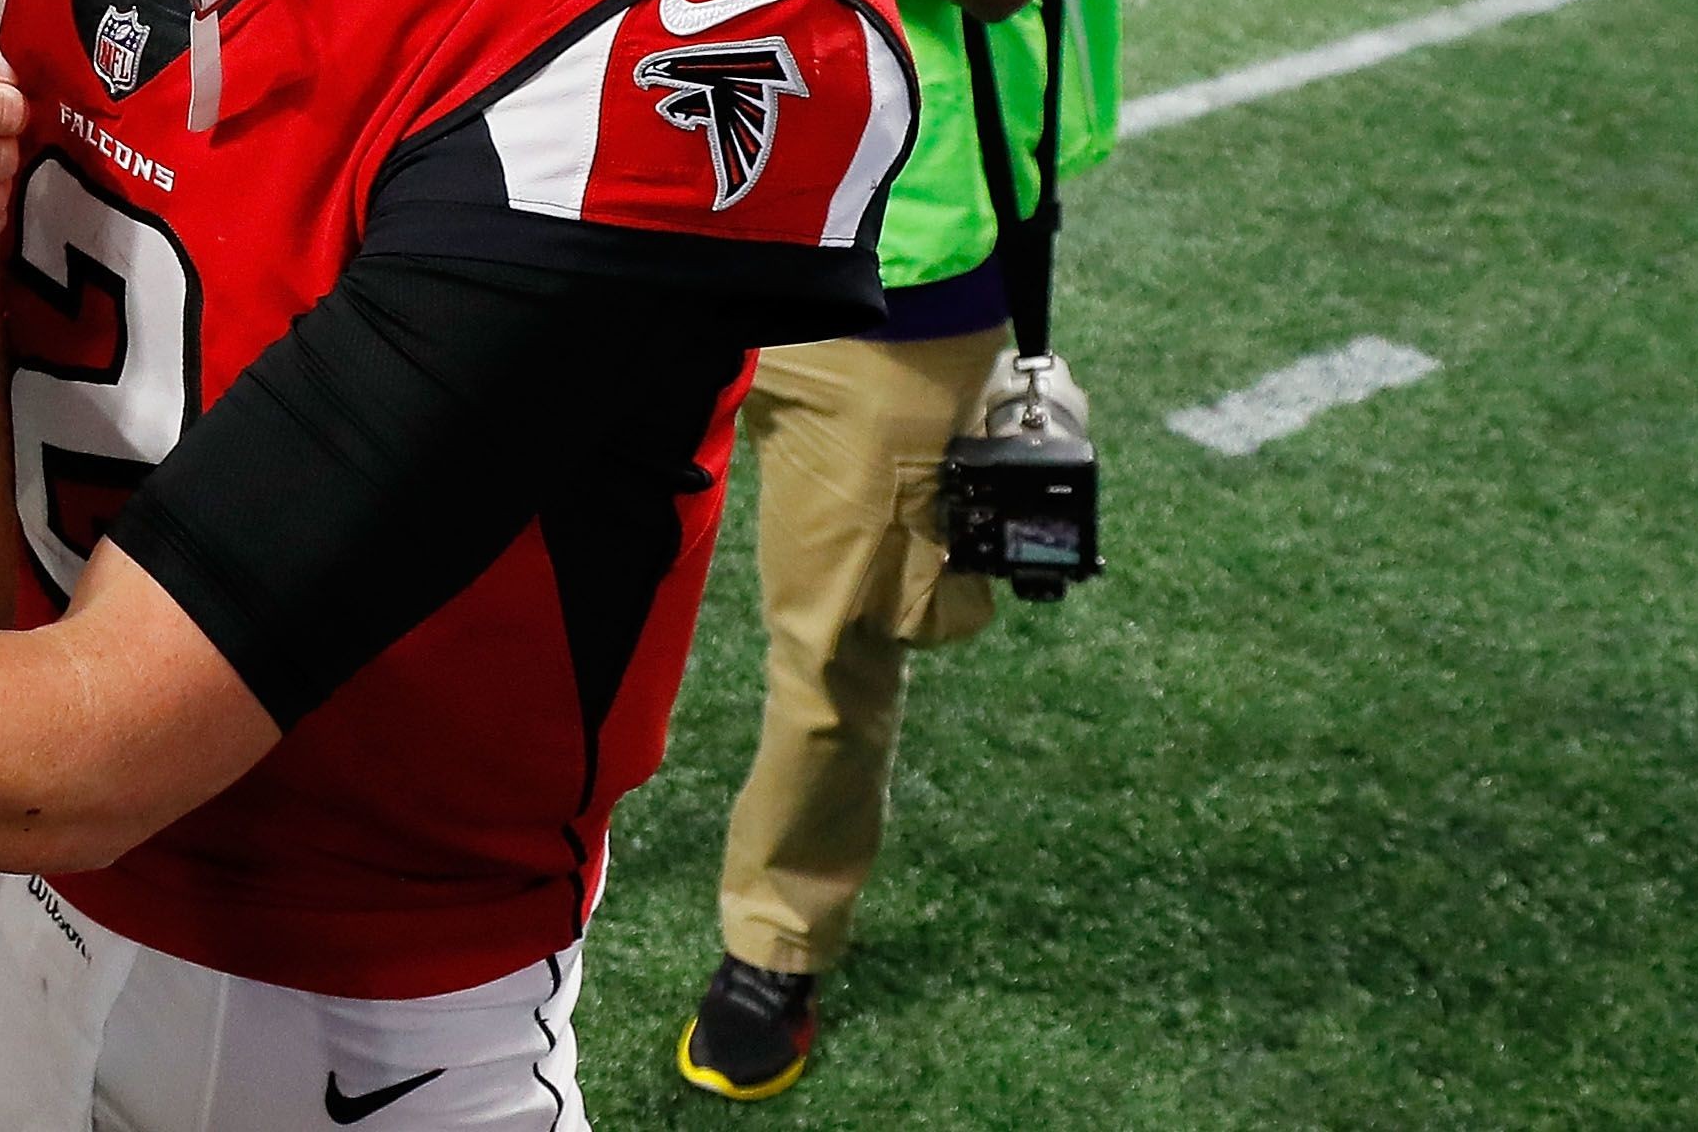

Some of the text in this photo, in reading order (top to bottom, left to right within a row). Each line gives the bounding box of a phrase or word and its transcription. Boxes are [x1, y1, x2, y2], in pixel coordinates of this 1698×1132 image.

[99, 38, 135, 81] NFL
[59, 102, 175, 192] FALCONS
[9, 148, 202, 612] 2
